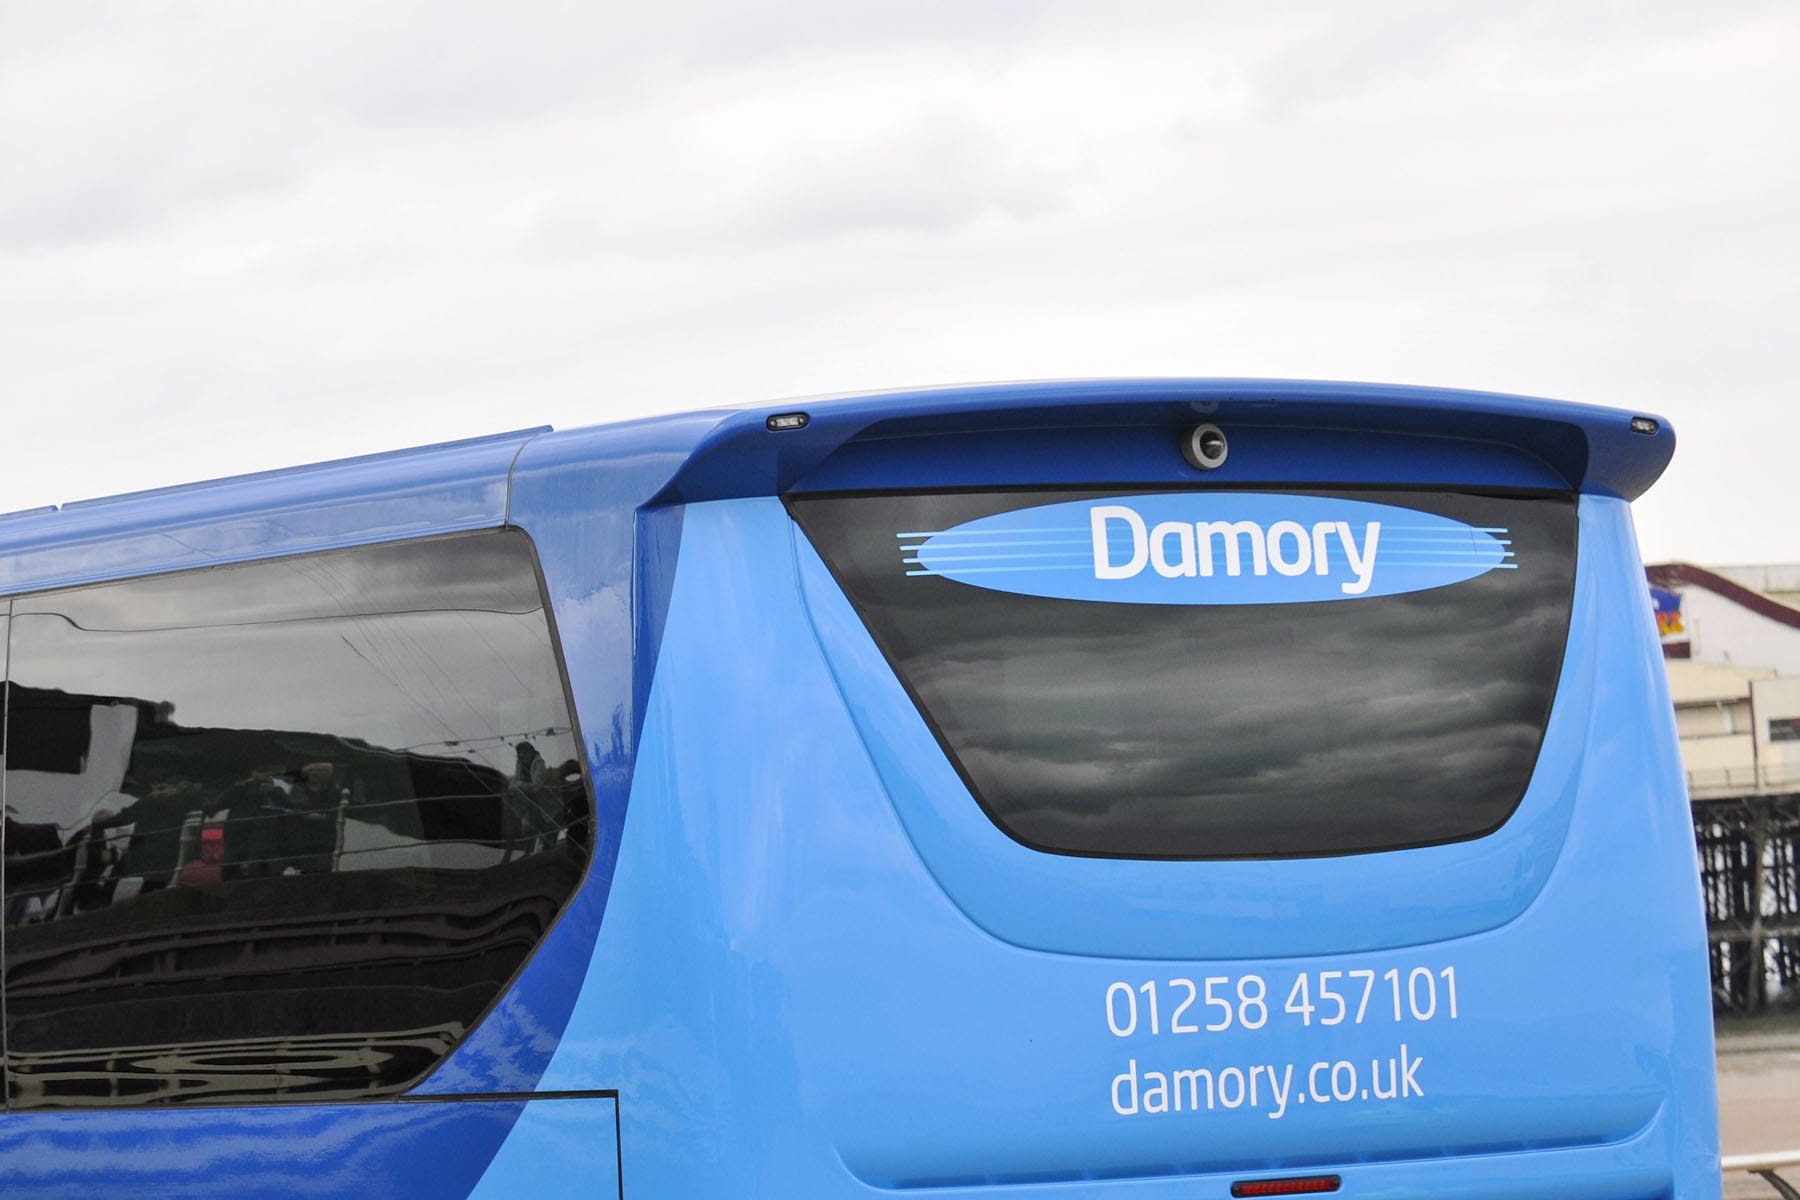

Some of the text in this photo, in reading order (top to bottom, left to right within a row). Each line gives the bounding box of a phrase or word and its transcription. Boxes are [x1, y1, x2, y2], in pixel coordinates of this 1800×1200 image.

[1090, 505, 1381, 594] Damory
[1105, 966, 1457, 1037] 01258 457101
[1111, 1043, 1424, 1119] damory.co.uk
